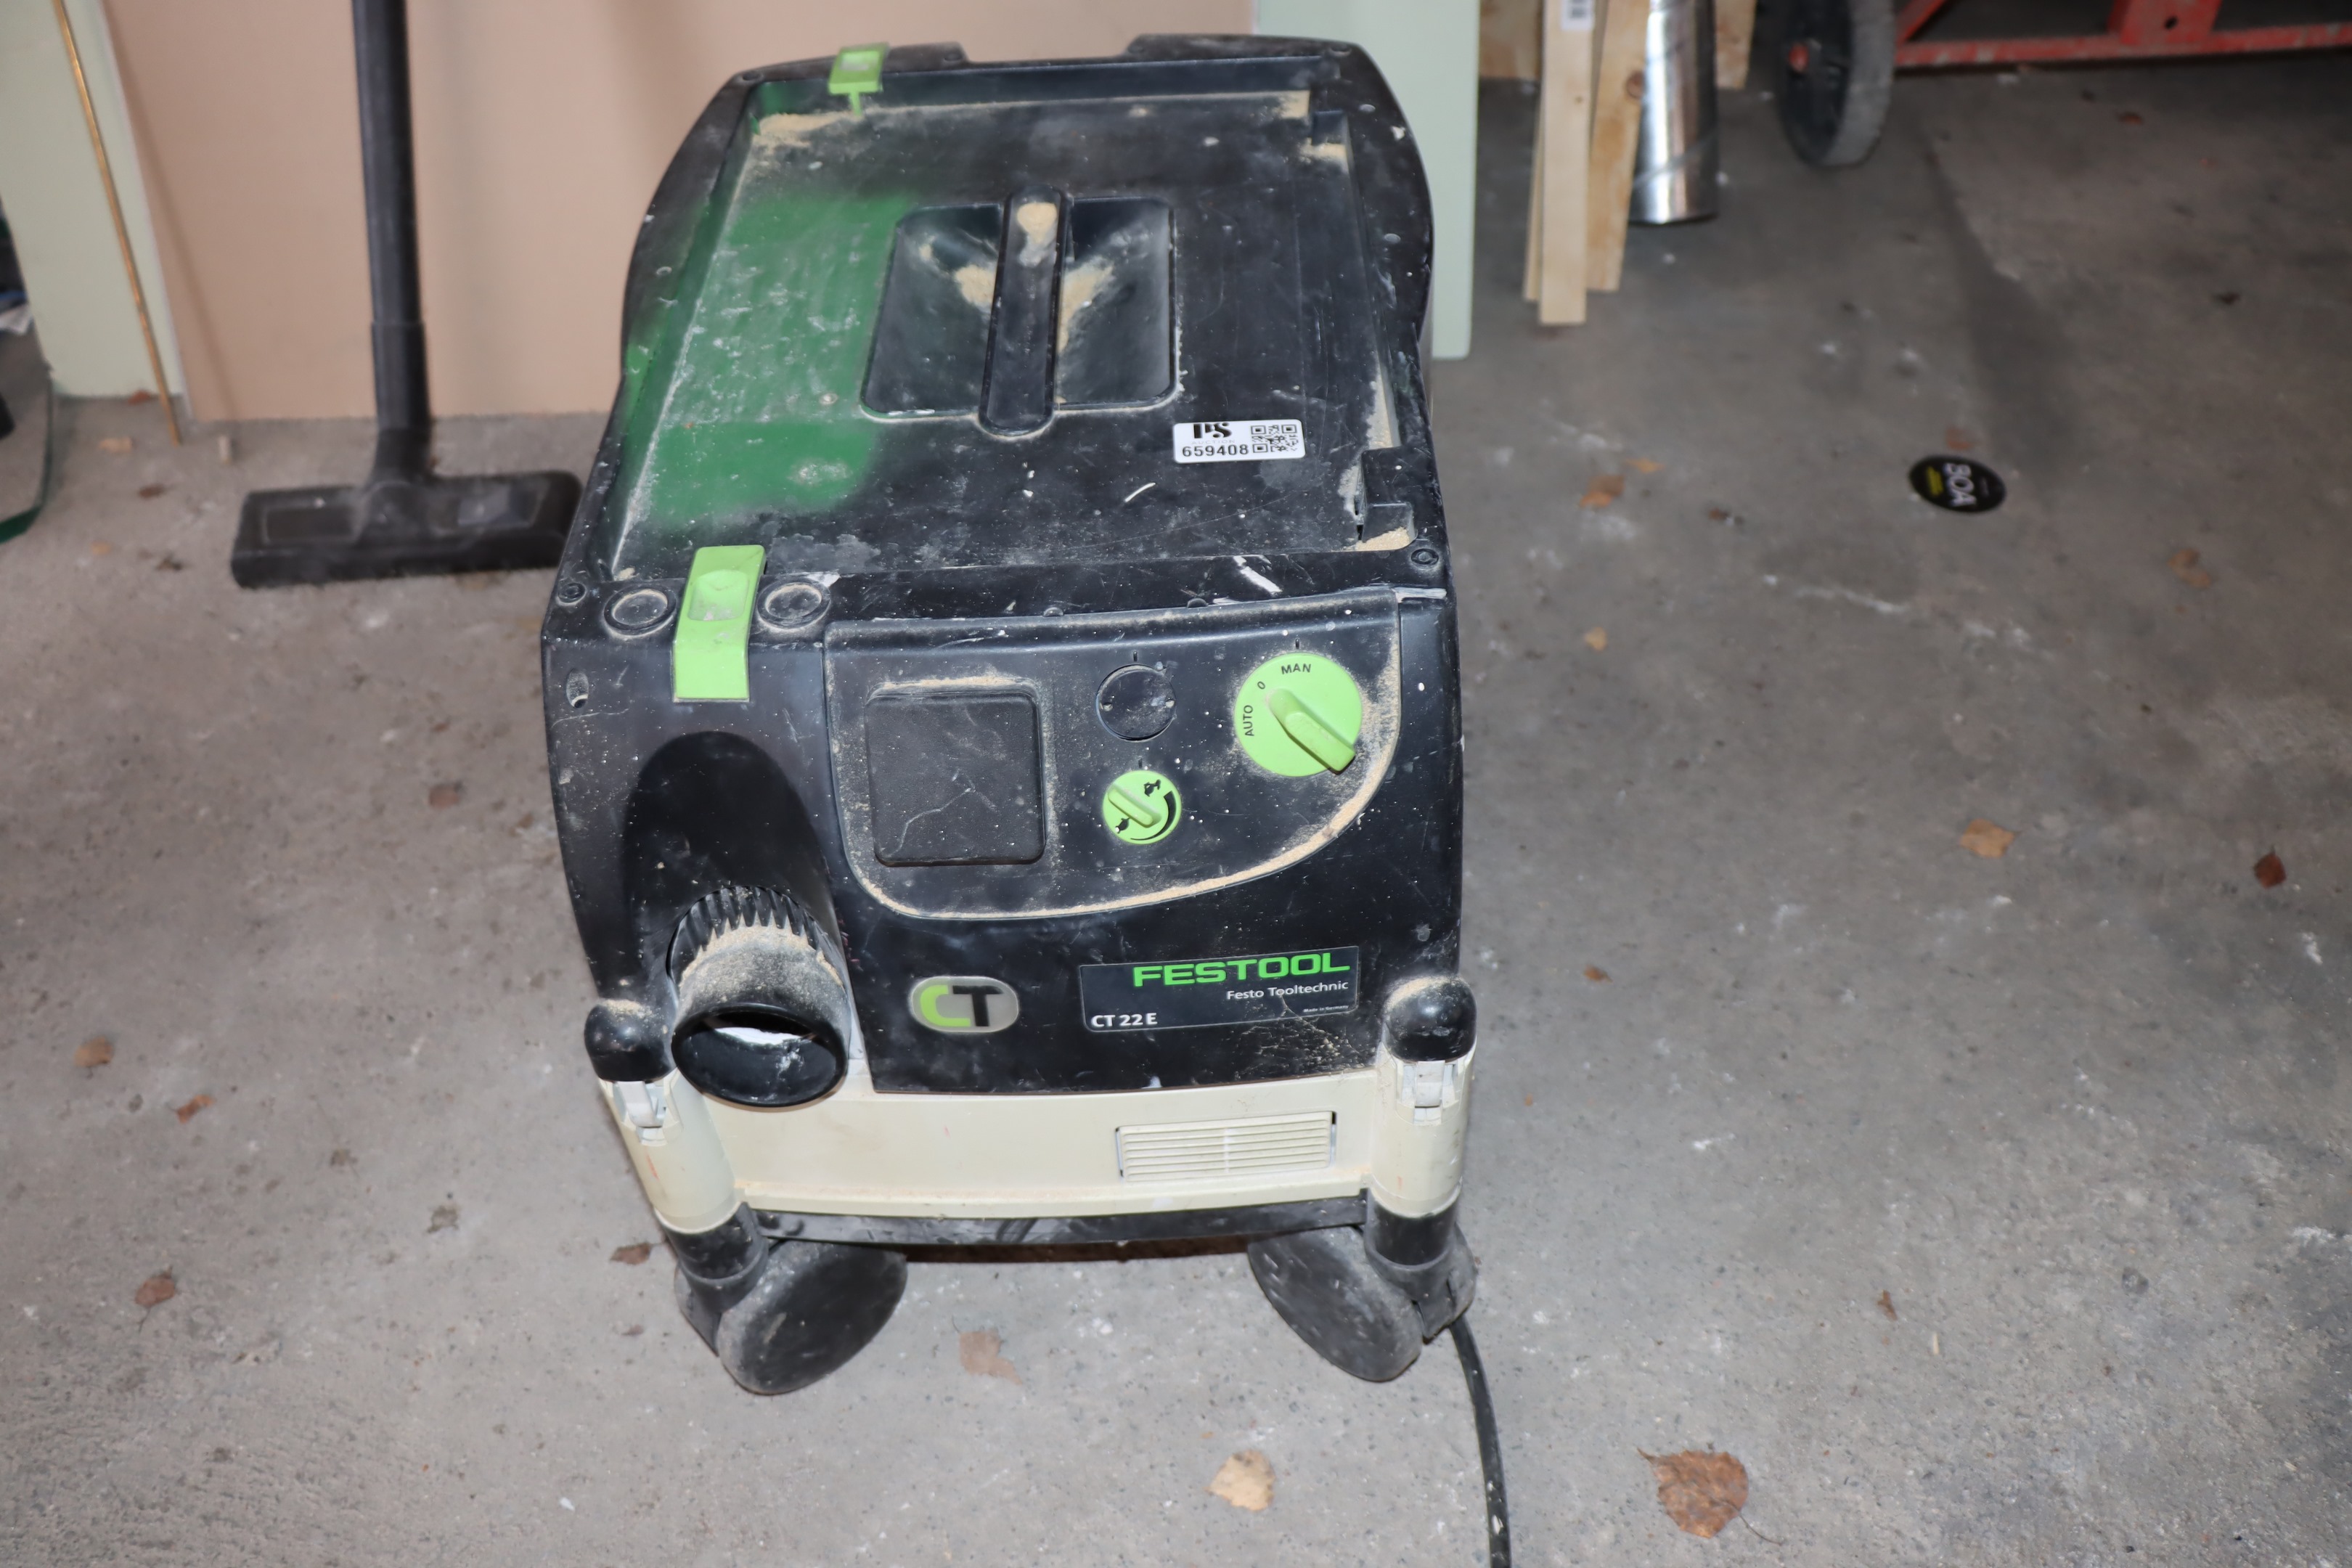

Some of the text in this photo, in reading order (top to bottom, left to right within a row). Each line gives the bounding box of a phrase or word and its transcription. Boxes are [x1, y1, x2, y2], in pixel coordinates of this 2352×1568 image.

[1182, 444, 1249, 457] 659408
[1281, 663, 1312, 675] MAN
[1243, 705, 1254, 737] AUTO
[1133, 952, 1350, 987] FESTOOL
[1226, 980, 1349, 1000] Festo Tooltechnic
[920, 984, 1004, 1027] CT
[1091, 1013, 1158, 1027] CT 22 E
